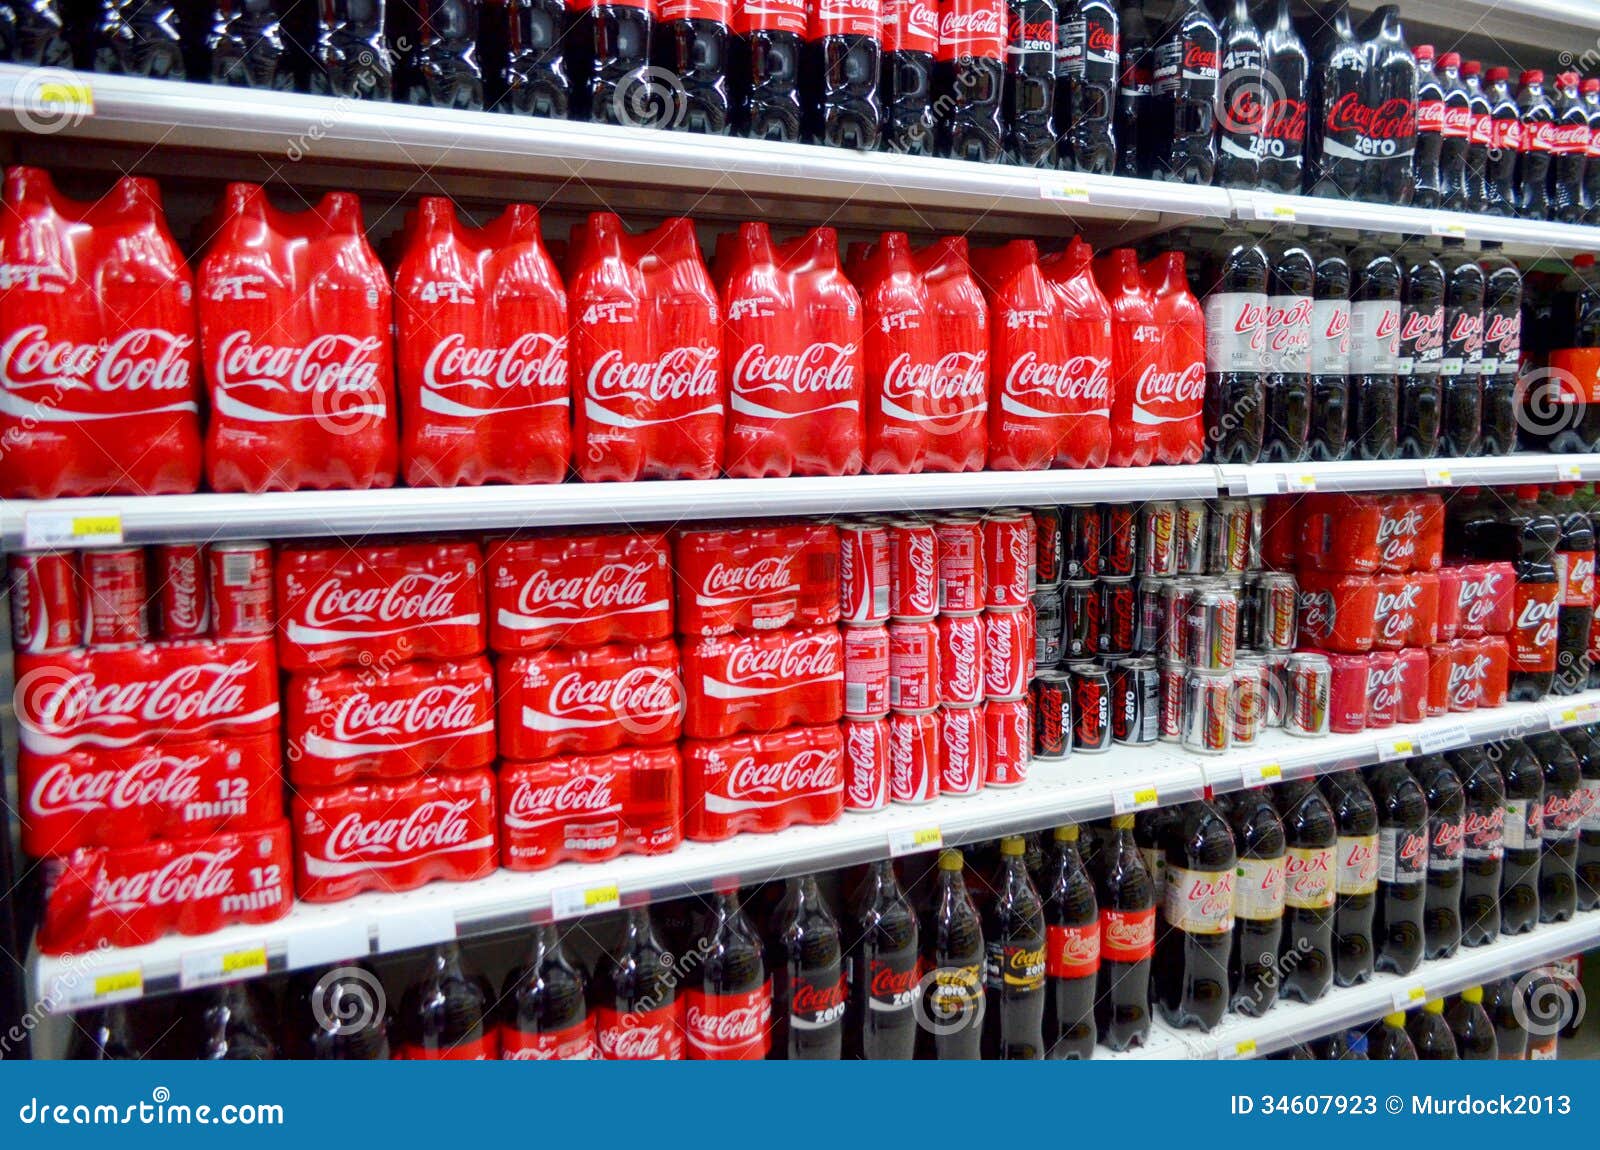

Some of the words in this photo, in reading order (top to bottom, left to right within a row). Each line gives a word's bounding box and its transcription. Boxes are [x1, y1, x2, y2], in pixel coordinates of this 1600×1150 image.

[941, 10, 1000, 35] Coca-Cola
[1024, 39, 1051, 50] zero
[1327, 92, 1416, 139] Coca-Cola
[1250, 136, 1285, 157] zero
[1354, 135, 1396, 155] zero
[0, 325, 194, 391] Coca-Cola
[217, 330, 382, 393] Coca-Cola
[424, 332, 569, 390] Coca-Cola
[587, 346, 720, 401] Coca-Cola
[732, 342, 857, 393] Coca-Cola
[884, 351, 988, 399] Coca-Cola
[1006, 351, 1111, 400] Coca-Cola
[1376, 510, 1422, 544] Look
[1383, 539, 1415, 561] Cola
[518, 562, 653, 614] Coca-Cola
[703, 555, 796, 596] Coca-Cola
[909, 532, 935, 616] Coca-Cola
[1458, 572, 1502, 608] Look
[305, 571, 462, 627] Coca-Cola
[1374, 583, 1423, 621] Look
[1468, 599, 1495, 623] Cola
[1517, 591, 1559, 628] Loo
[1383, 613, 1414, 637] Cola
[726, 634, 838, 684] Coca-Cola
[949, 618, 976, 701] Coca-Cola
[985, 615, 1011, 696] Coca-Cola
[1448, 654, 1492, 690] Look
[43, 659, 258, 733] Coca-Cola
[549, 666, 675, 716] Coca-Cola
[1366, 658, 1408, 696] Look
[1455, 682, 1483, 704] Cola
[334, 683, 482, 741] Coca-Cola
[1061, 702, 1070, 734] zero
[1099, 697, 1107, 727] zero
[1125, 692, 1135, 720] zero
[1373, 689, 1402, 711] Cola
[848, 722, 875, 807] Coca-Cola
[943, 707, 970, 792] Coca-Cola
[30, 756, 209, 815] Coca-Cola
[215, 778, 249, 799] 12
[727, 749, 840, 798] Coca-Cola
[184, 799, 248, 822] mini
[509, 773, 616, 818] Coca-Cola
[325, 798, 476, 861] Coca-Cola
[90, 846, 243, 917] oca-Cola
[250, 864, 280, 887] 12
[1285, 852, 1331, 877] Look
[222, 886, 282, 913] mini
[1189, 871, 1232, 900] Look
[815, 1001, 845, 1023] zero
[893, 985, 921, 1005] zero
[686, 1006, 758, 1040] Coca-Cola
